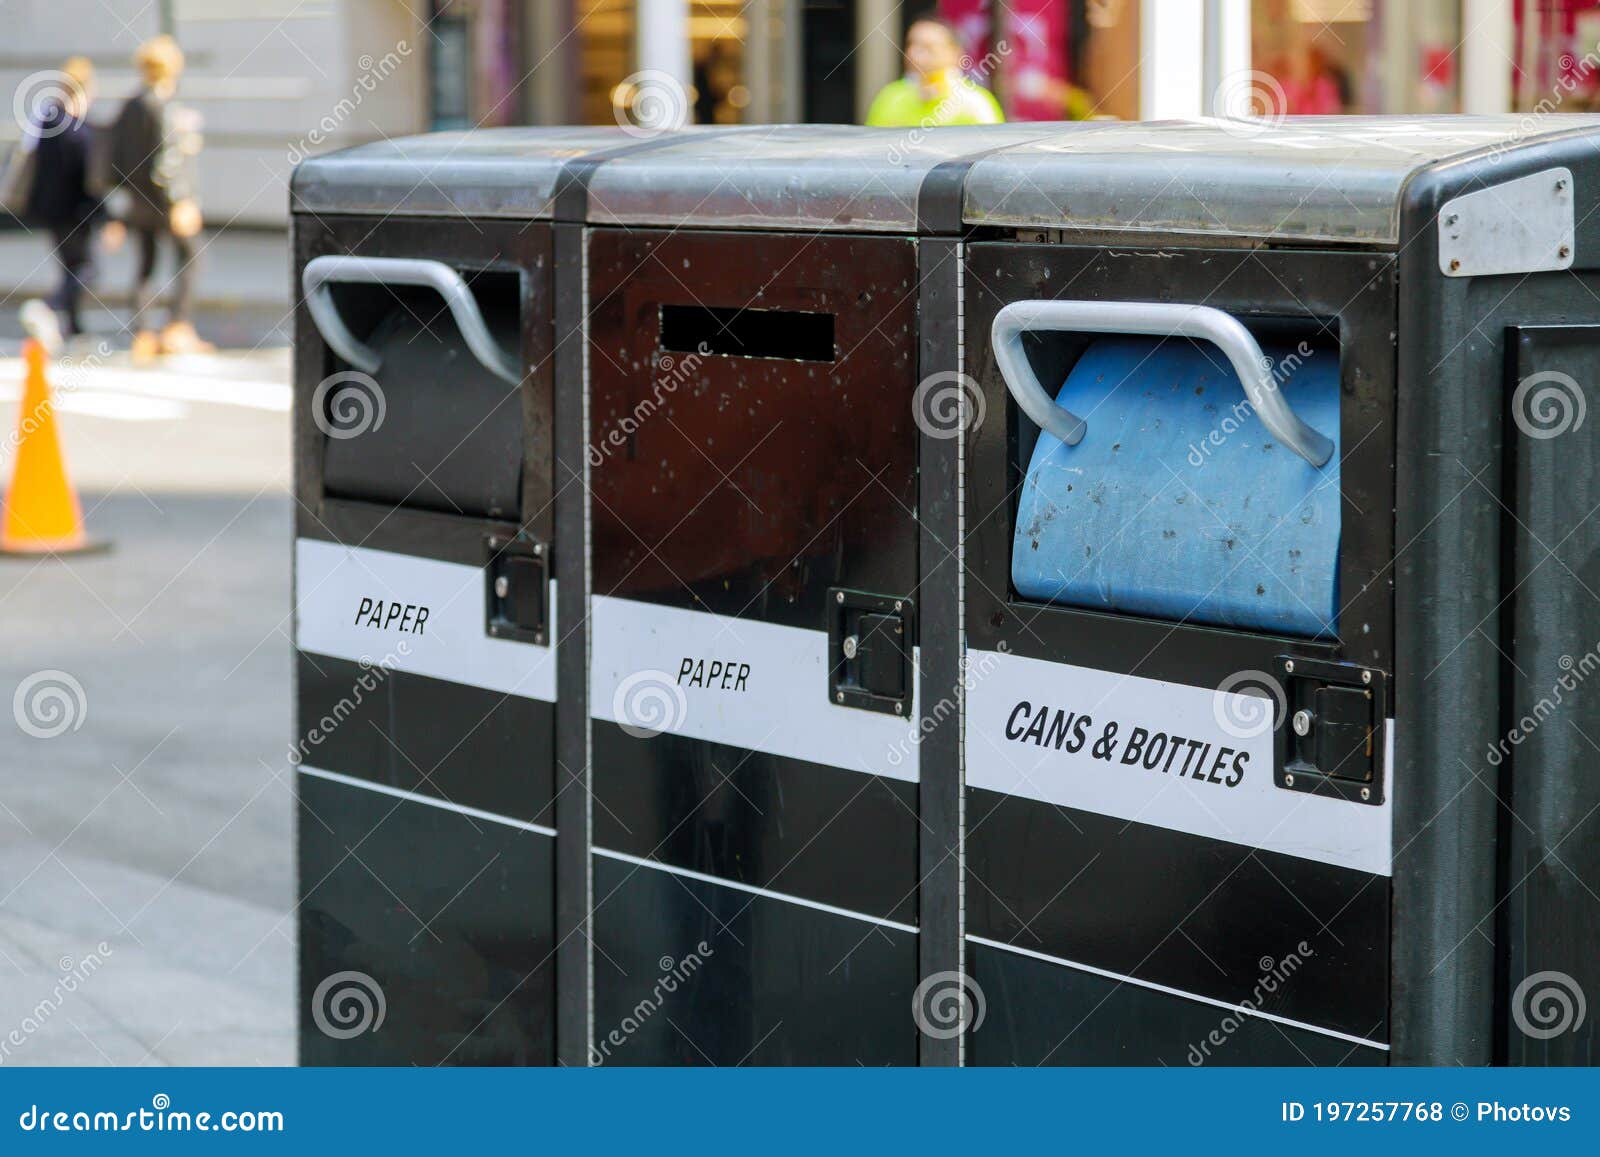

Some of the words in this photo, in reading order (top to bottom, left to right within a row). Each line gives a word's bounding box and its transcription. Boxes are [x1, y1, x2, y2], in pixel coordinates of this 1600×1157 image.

[355, 597, 430, 636] PAPER
[678, 657, 751, 692] PAPER
[1005, 700, 1092, 754] CANS
[1092, 721, 1119, 762] &
[1120, 727, 1250, 788] BOTTLES
